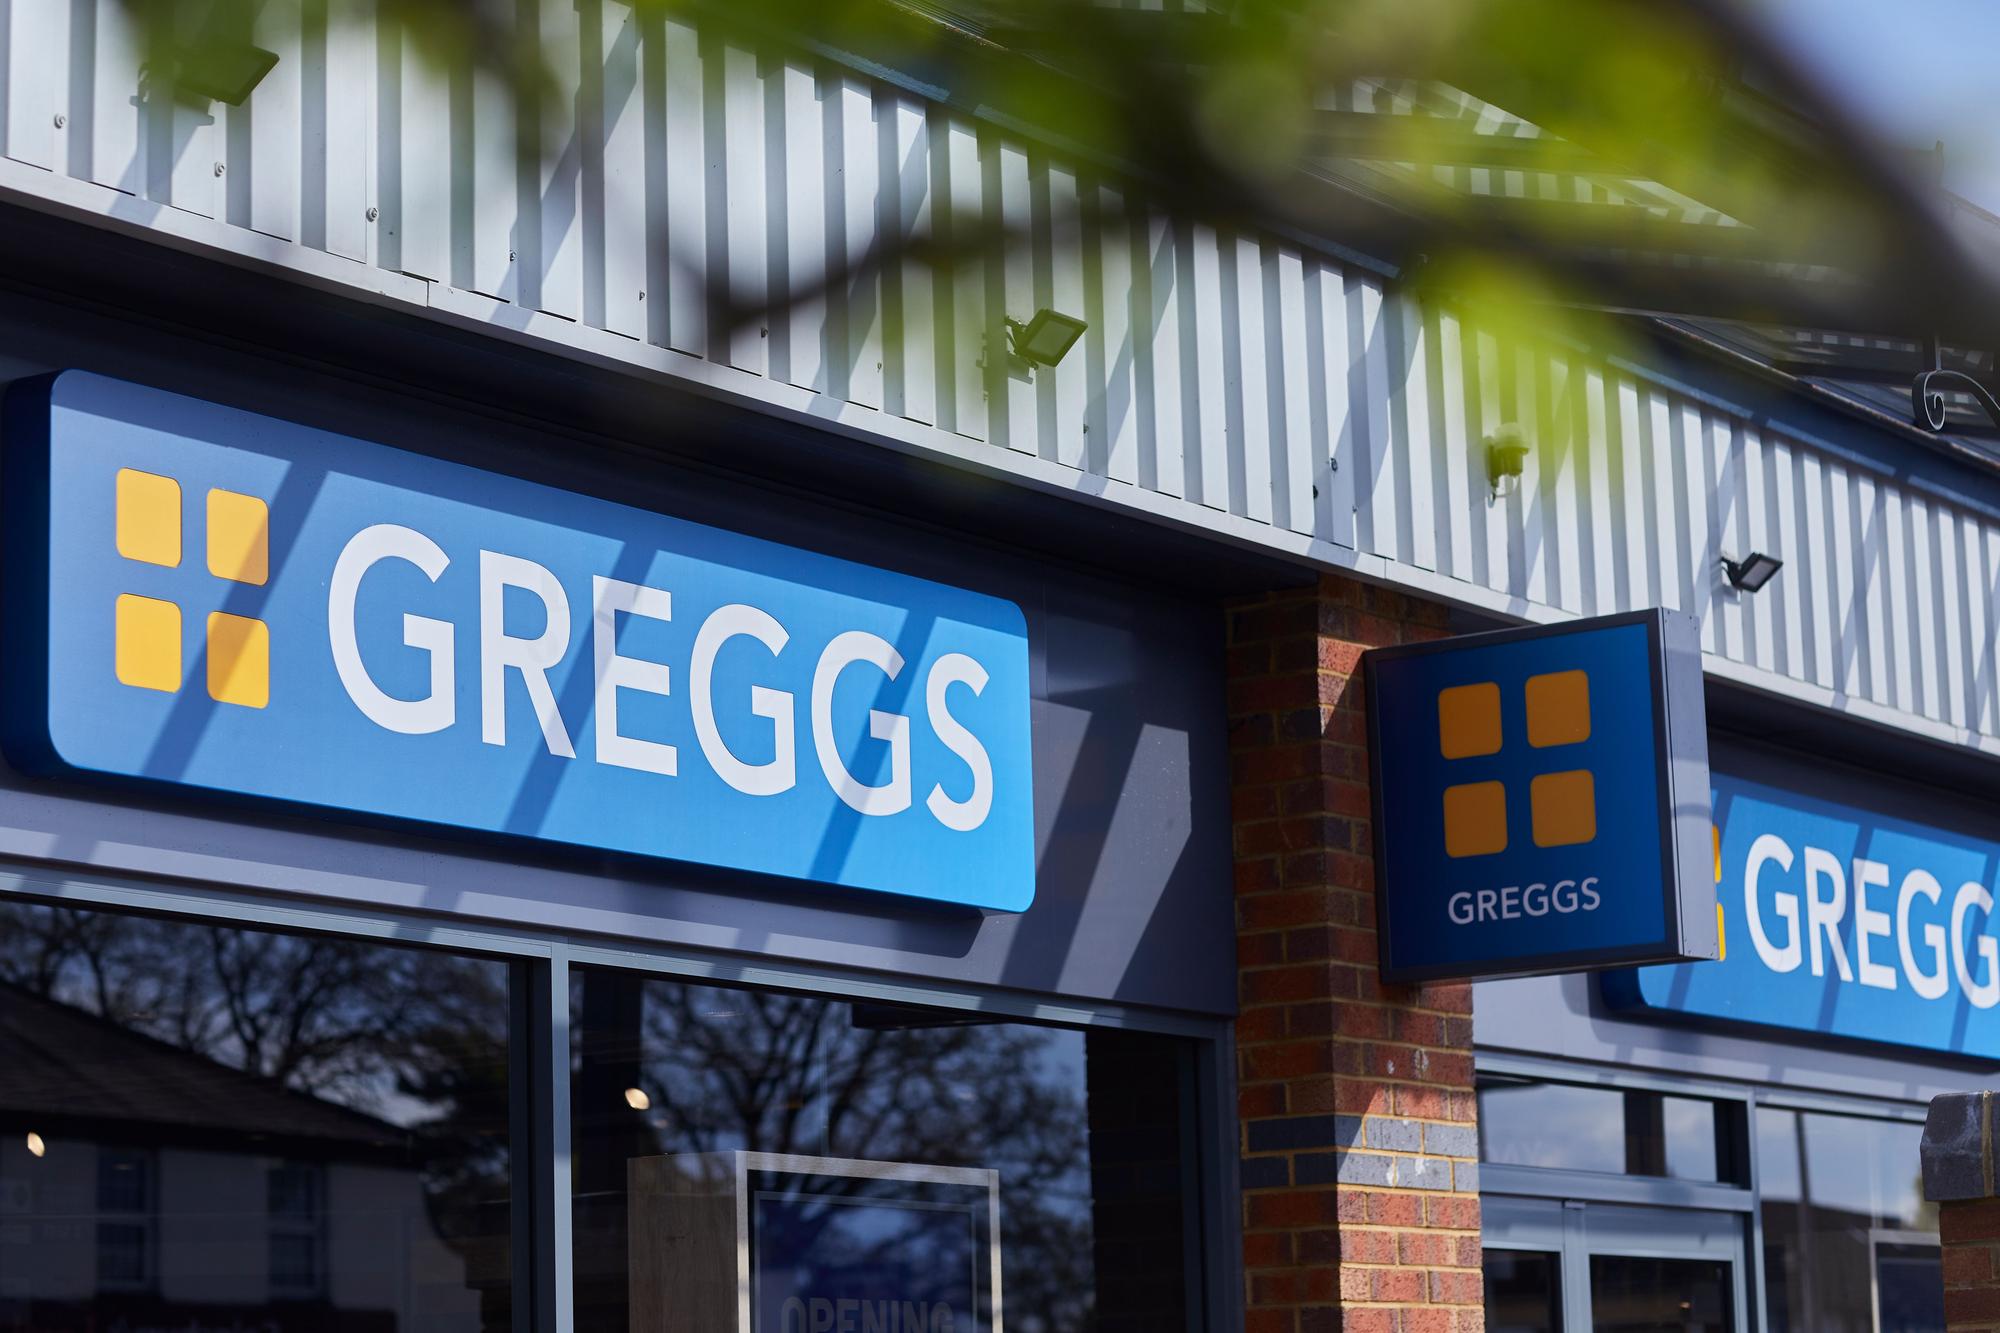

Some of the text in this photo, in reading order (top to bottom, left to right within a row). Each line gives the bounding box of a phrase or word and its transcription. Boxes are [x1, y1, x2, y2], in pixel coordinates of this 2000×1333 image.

[328, 523, 994, 832] GREGGS
[1447, 876, 1601, 925] GREGGS
[780, 1296, 955, 1333] OPENING
